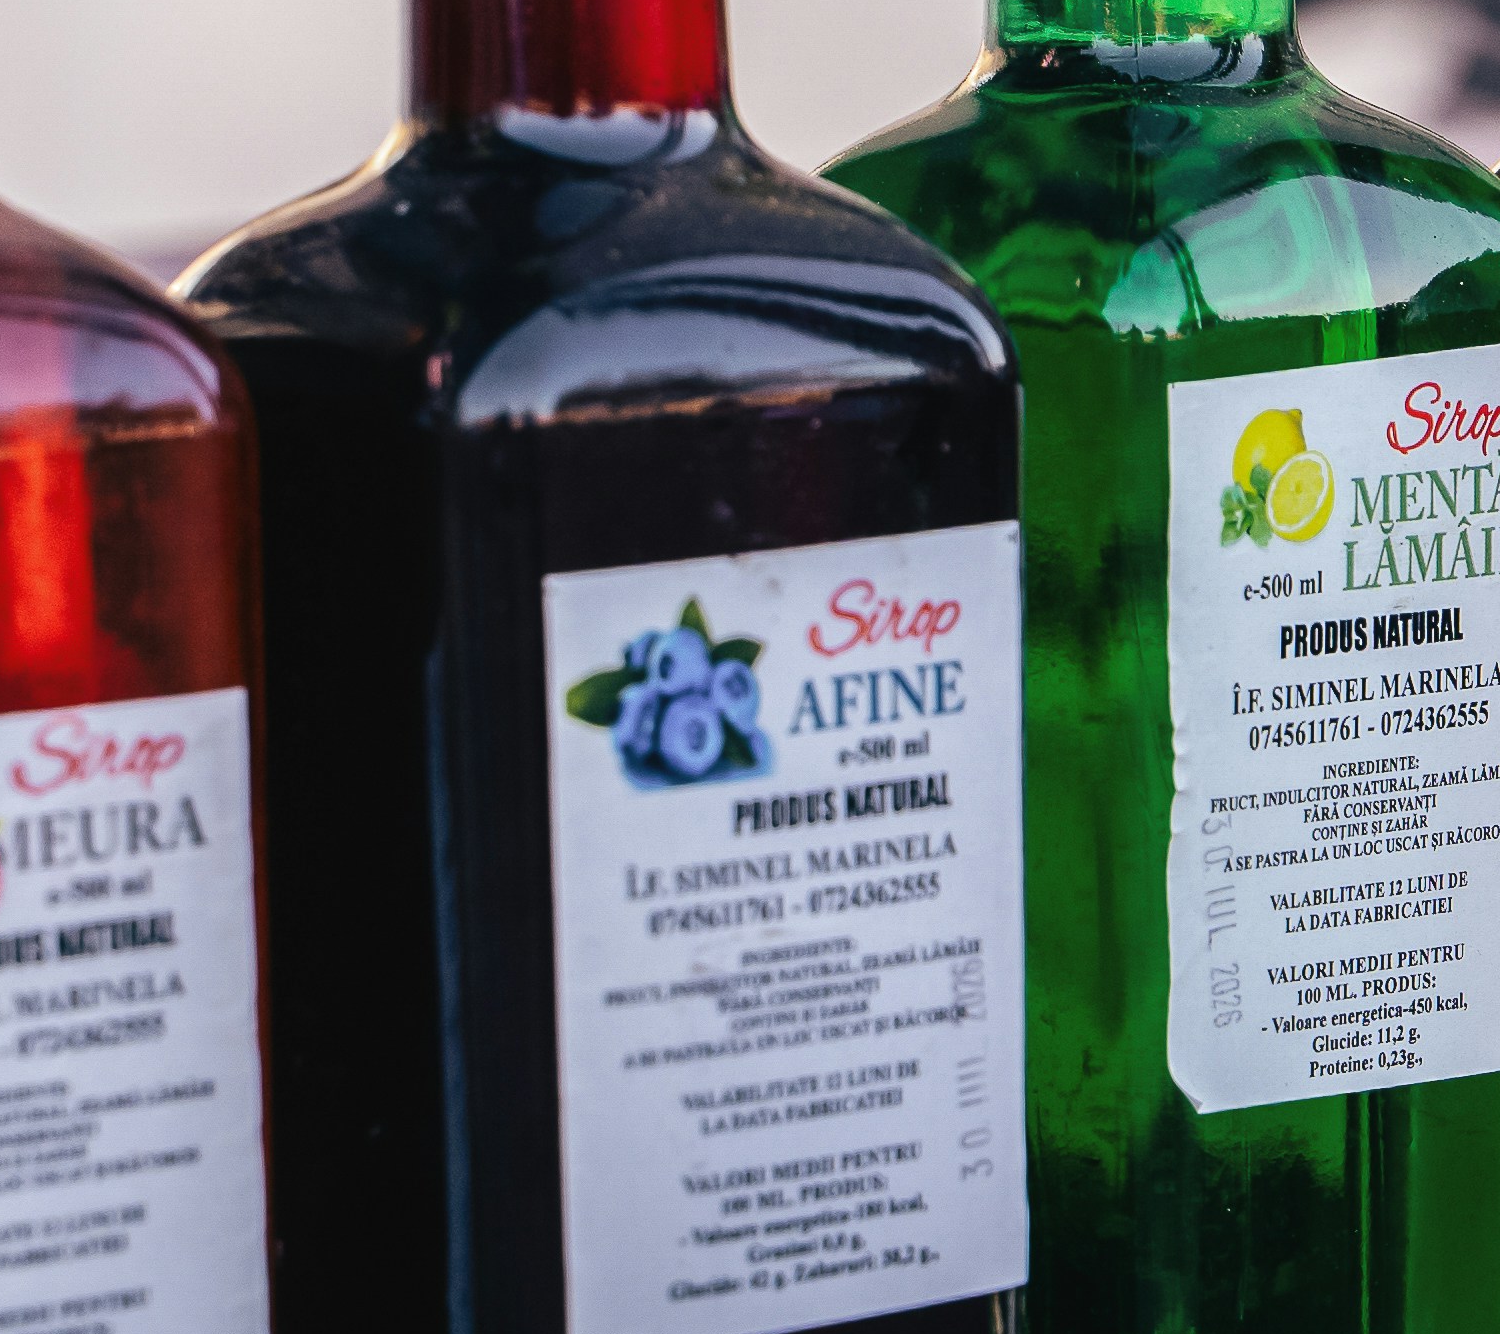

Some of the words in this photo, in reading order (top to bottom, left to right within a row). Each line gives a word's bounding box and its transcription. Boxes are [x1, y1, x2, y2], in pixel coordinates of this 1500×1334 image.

[1299, 570, 1322, 595] ml
[805, 578, 961, 658] Sirop
[1280, 616, 1367, 659] PRODUS
[1372, 607, 1463, 649] NATURAL
[788, 660, 965, 734] AFINE
[1232, 682, 1263, 715] Î.F.
[1271, 676, 1374, 710] SIMINEL
[1249, 714, 1359, 750] 0745611761
[1380, 699, 1488, 735] 0724362555
[9, 712, 186, 796] Sirop
[1323, 755, 1419, 779] INGREDIENTE:
[1210, 794, 1259, 813] FRUCT,
[1262, 783, 1349, 807] INDULCITOR
[1351, 775, 1419, 796] NATURAL,
[1421, 765, 1468, 788] ZEAMĂ
[1303, 801, 1339, 823] FĂRĂ
[1385, 813, 1428, 832] ZAHĂR
[1235, 855, 1252, 871] SE
[1255, 849, 1308, 869] PASTRA
[1311, 846, 1329, 862] LA
[1332, 843, 1351, 859] UN
[1353, 839, 1382, 856] LOC
[1385, 834, 1428, 853] USCAT
[1270, 881, 1385, 910] VALABILITATE
[1388, 879, 1402, 896] 12
[1406, 873, 1443, 894] LUNI
[1447, 870, 1468, 888] DE
[1285, 915, 1306, 933] LA
[1309, 910, 1351, 930] DATA
[1353, 896, 1452, 924] FABRICATIEI
[1267, 960, 1334, 984] VALORI
[1339, 952, 1392, 975] MEDII
[1396, 942, 1464, 968] PENTRU
[1297, 986, 1321, 1005] 100
[1325, 982, 1357, 1002] ML.
[1361, 971, 1436, 997] PRODUS:
[1271, 1014, 1326, 1033] Valoare
[1331, 996, 1432, 1026] energetica-450
[1436, 992, 1467, 1011] kcal,
[1312, 1030, 1372, 1052] Glucide:
[1377, 1024, 1404, 1045] 11,2
[1408, 1027, 1420, 1044] g.
[1309, 1055, 1373, 1077] Proteine:
